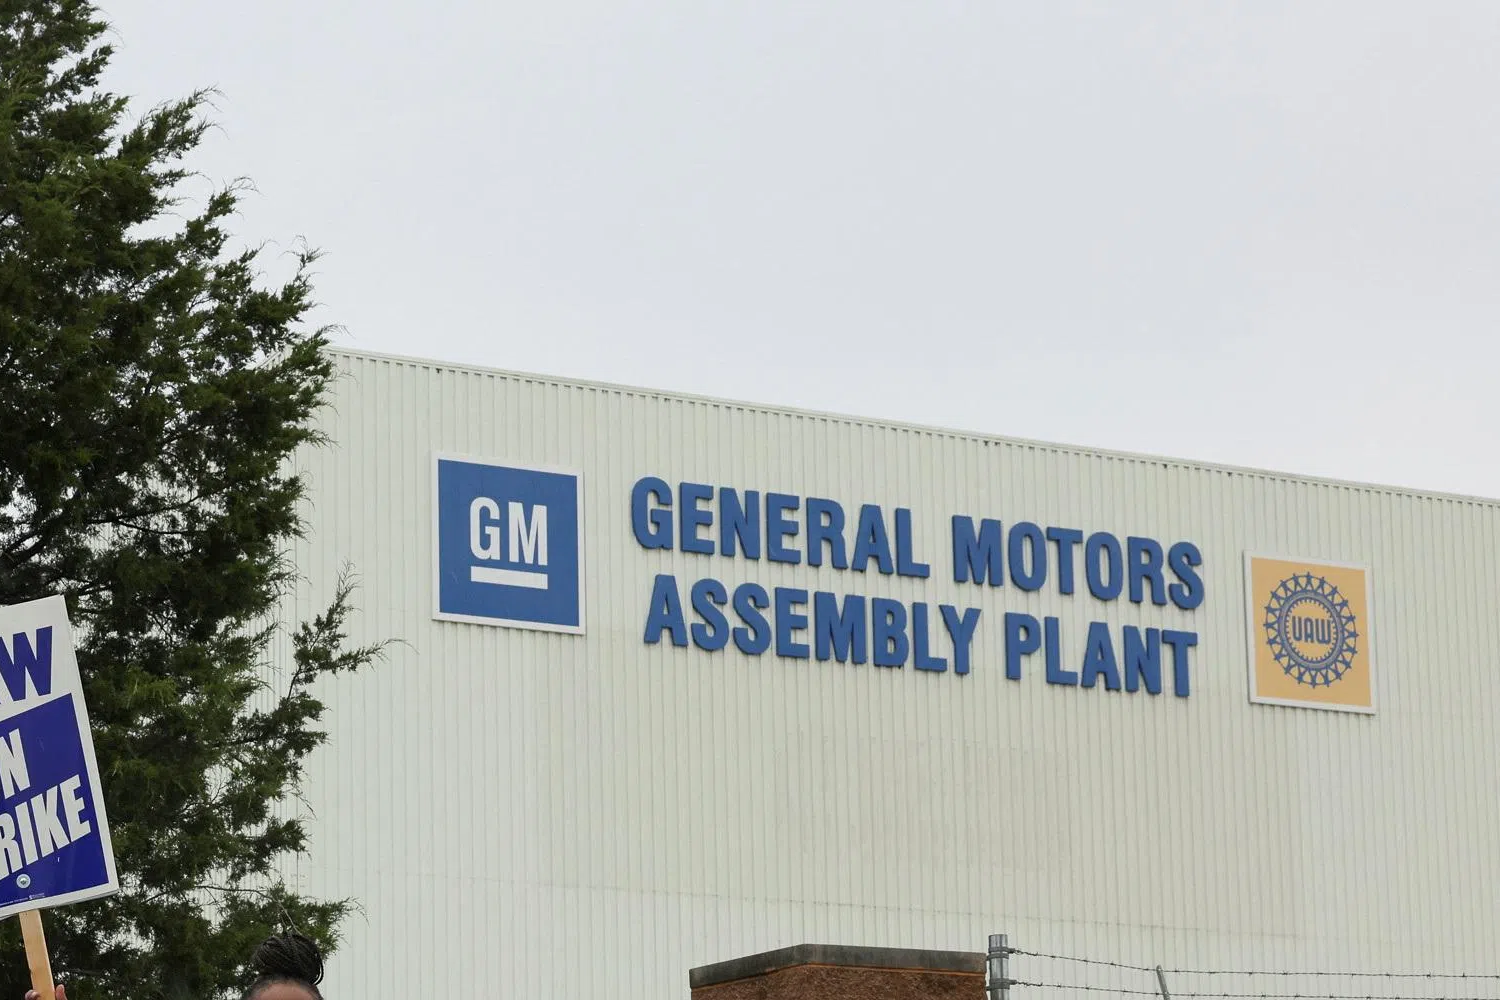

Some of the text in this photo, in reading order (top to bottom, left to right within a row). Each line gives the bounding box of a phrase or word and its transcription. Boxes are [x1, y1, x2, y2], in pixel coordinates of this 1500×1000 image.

[469, 495, 548, 566] GM
[631, 476, 1205, 609] GENERAL MOTORS
[643, 573, 1197, 698] ASSEMBLY PLANT
[1291, 615, 1332, 645] UAW
